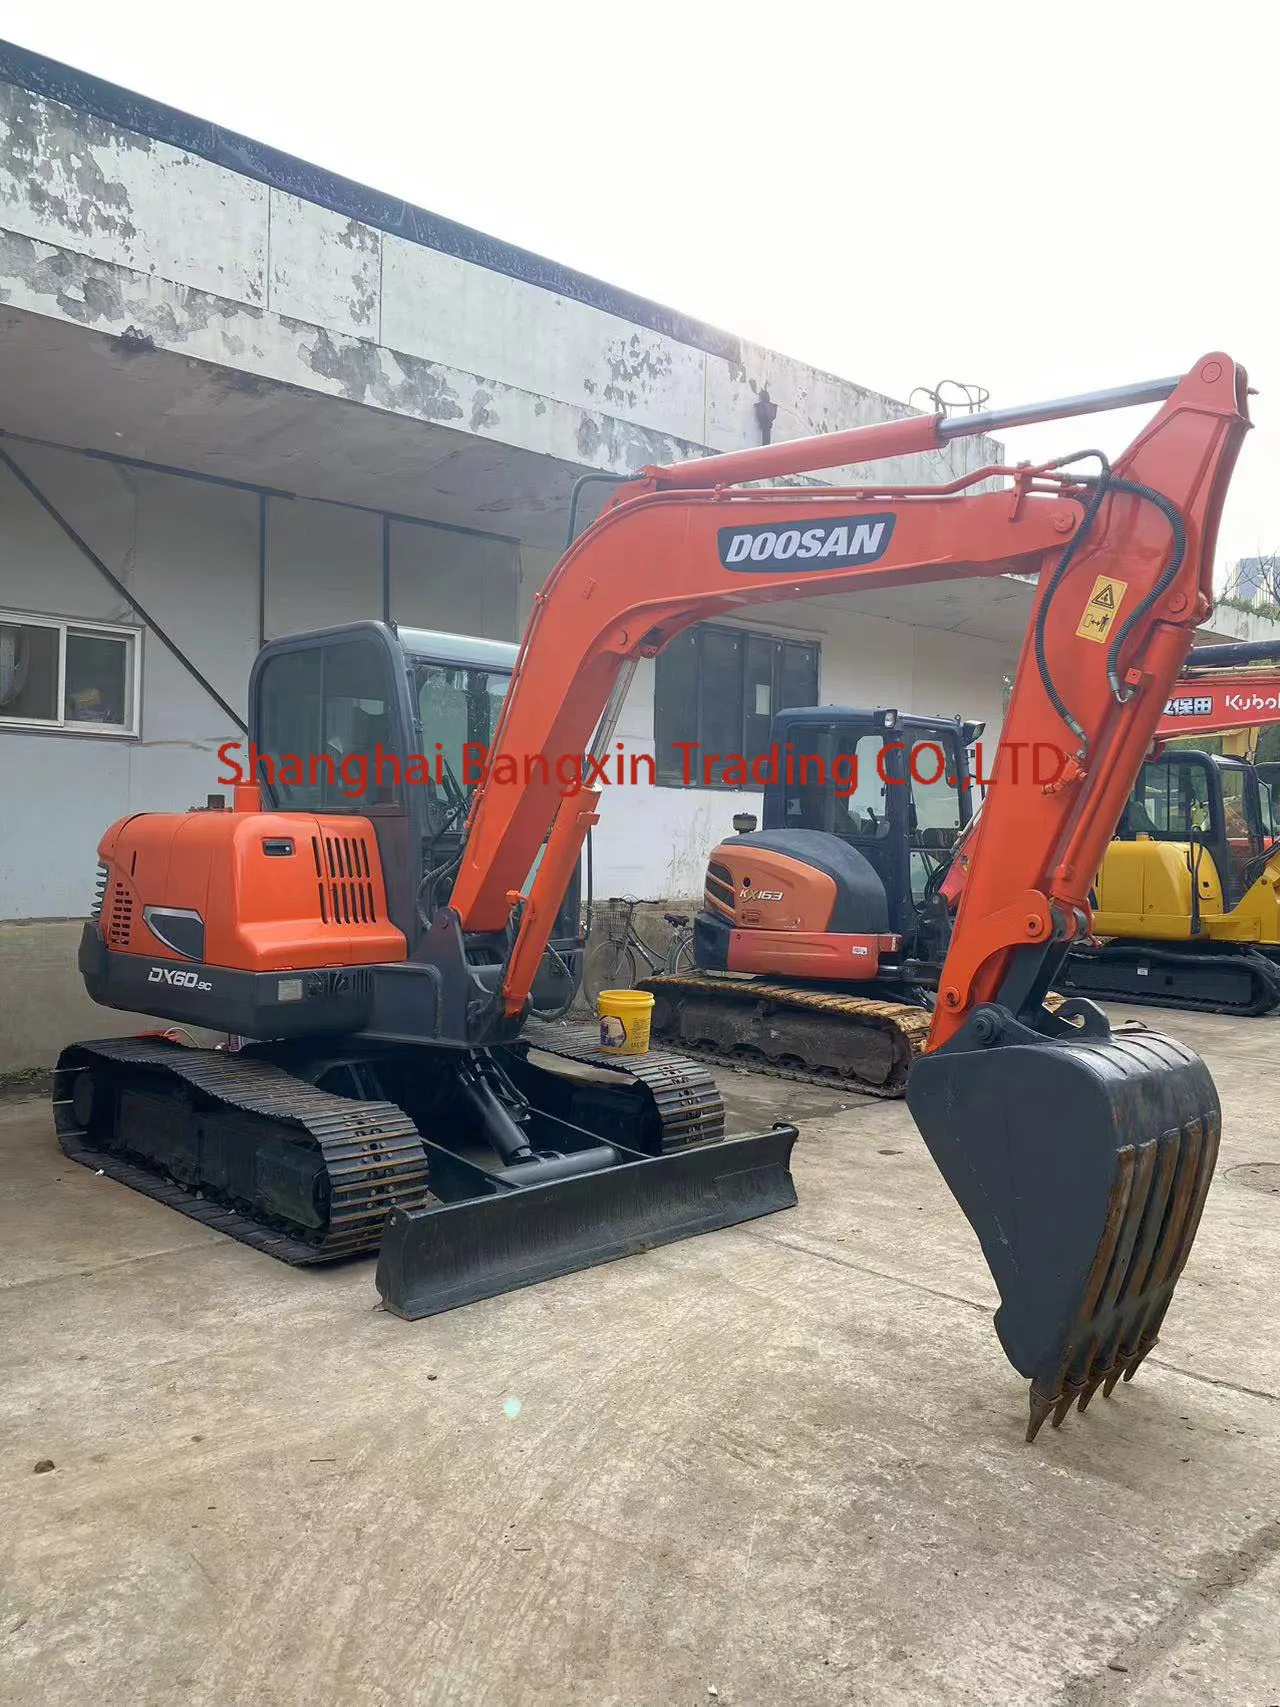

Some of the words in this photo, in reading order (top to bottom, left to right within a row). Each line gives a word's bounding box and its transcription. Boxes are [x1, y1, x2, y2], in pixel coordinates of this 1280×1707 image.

[726, 522, 885, 562] DOOSAN
[1225, 693, 1280, 711] Kubo
[739, 888, 784, 903] KX163
